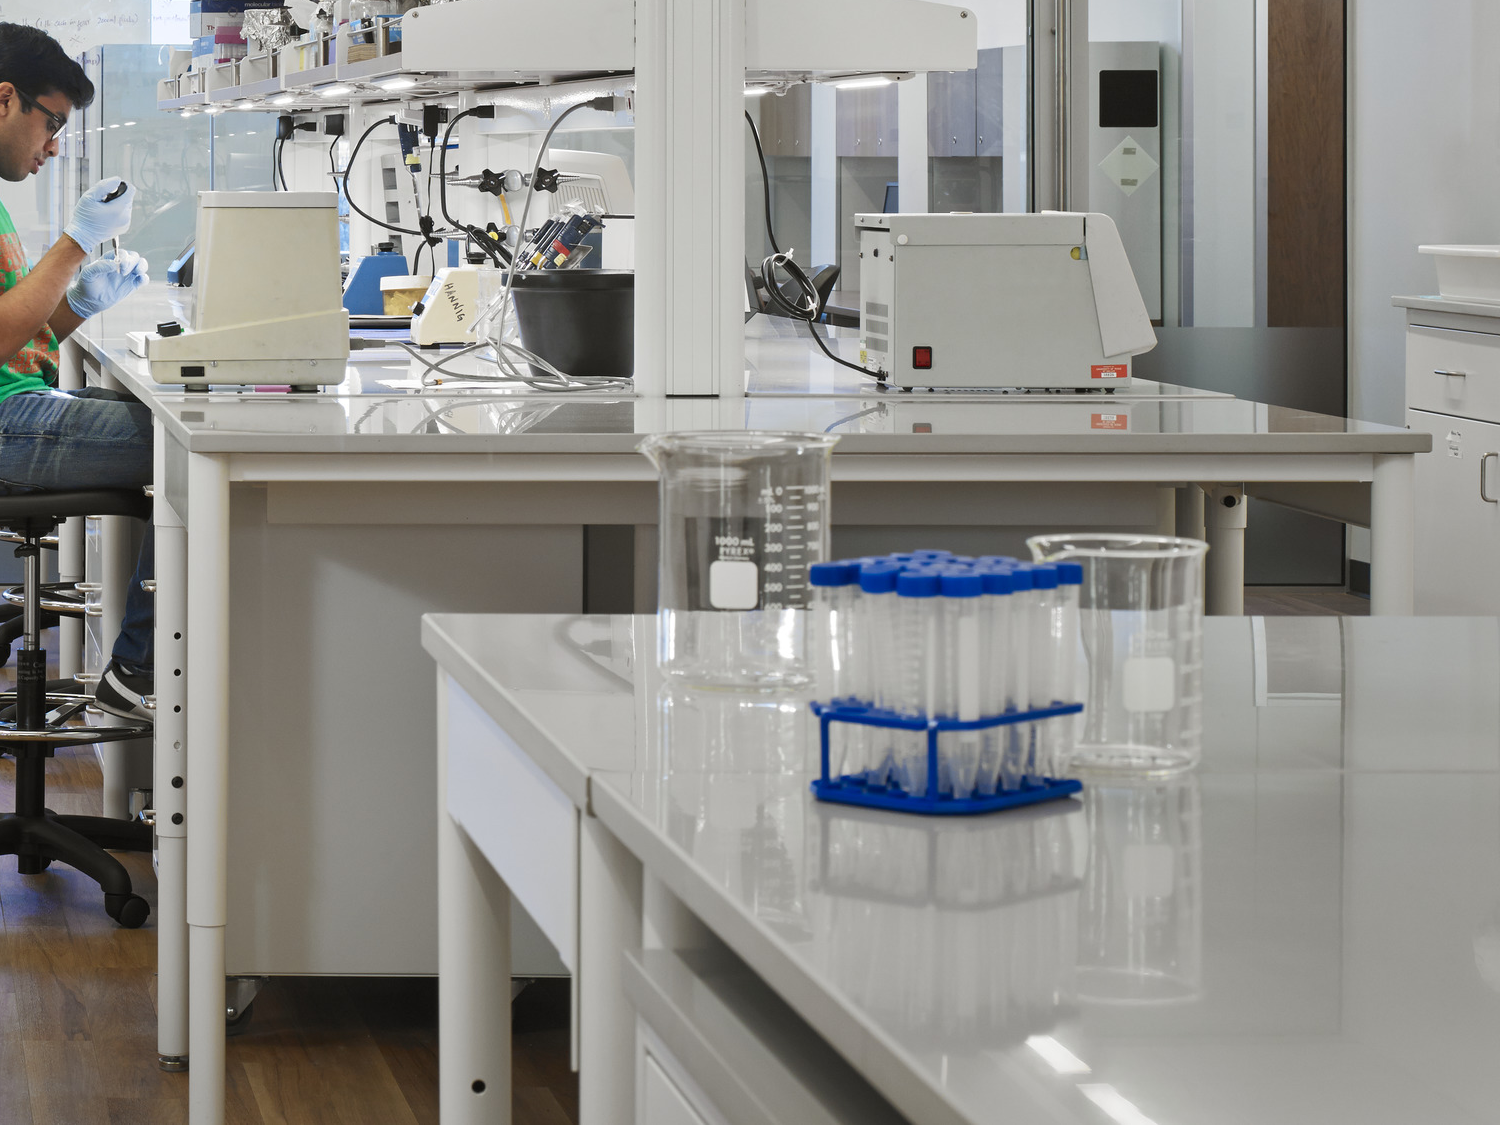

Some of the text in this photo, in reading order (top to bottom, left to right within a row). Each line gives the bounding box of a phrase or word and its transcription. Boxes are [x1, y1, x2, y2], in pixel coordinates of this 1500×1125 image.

[444, 282, 466, 322] HANNIG
[715, 536, 740, 547] 1000
[764, 562, 784, 573] 400
